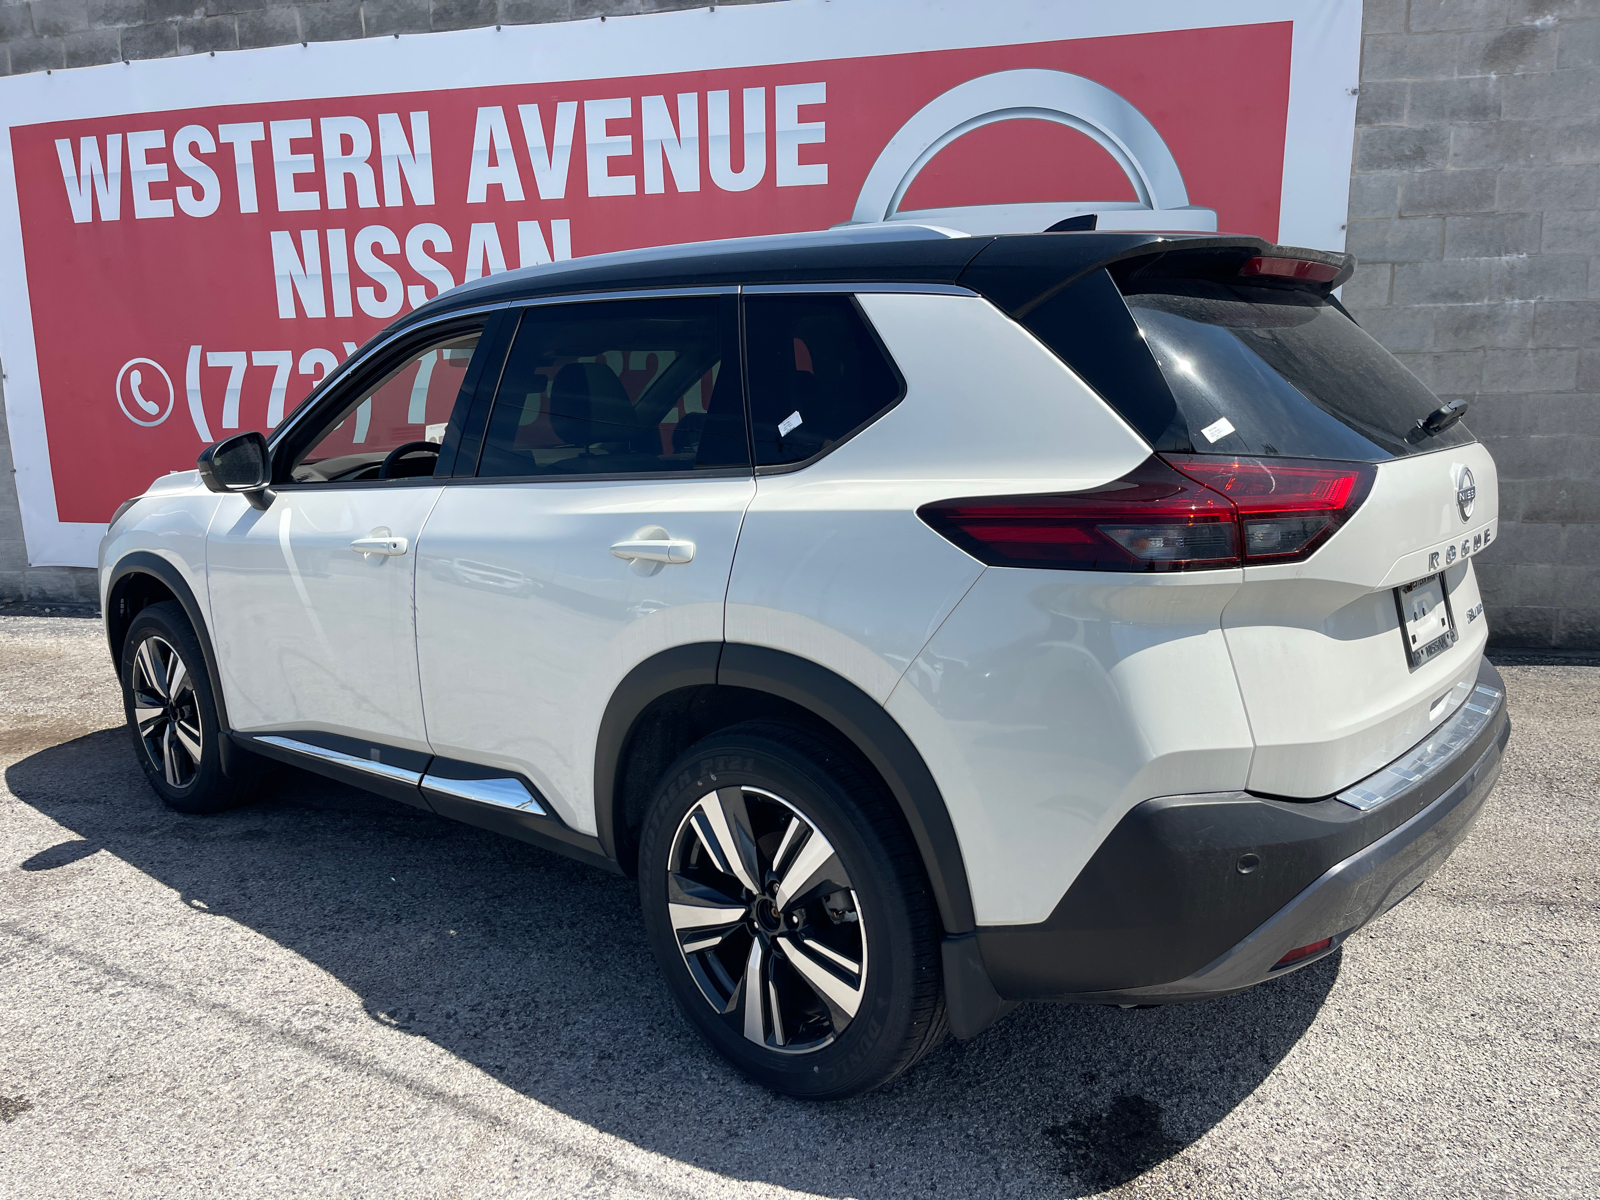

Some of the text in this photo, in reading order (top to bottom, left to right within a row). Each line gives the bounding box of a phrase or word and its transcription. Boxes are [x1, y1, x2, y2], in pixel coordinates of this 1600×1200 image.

[55, 82, 828, 223] WESTERN AVENUE
[1428, 528, 1491, 572] ROGUE
